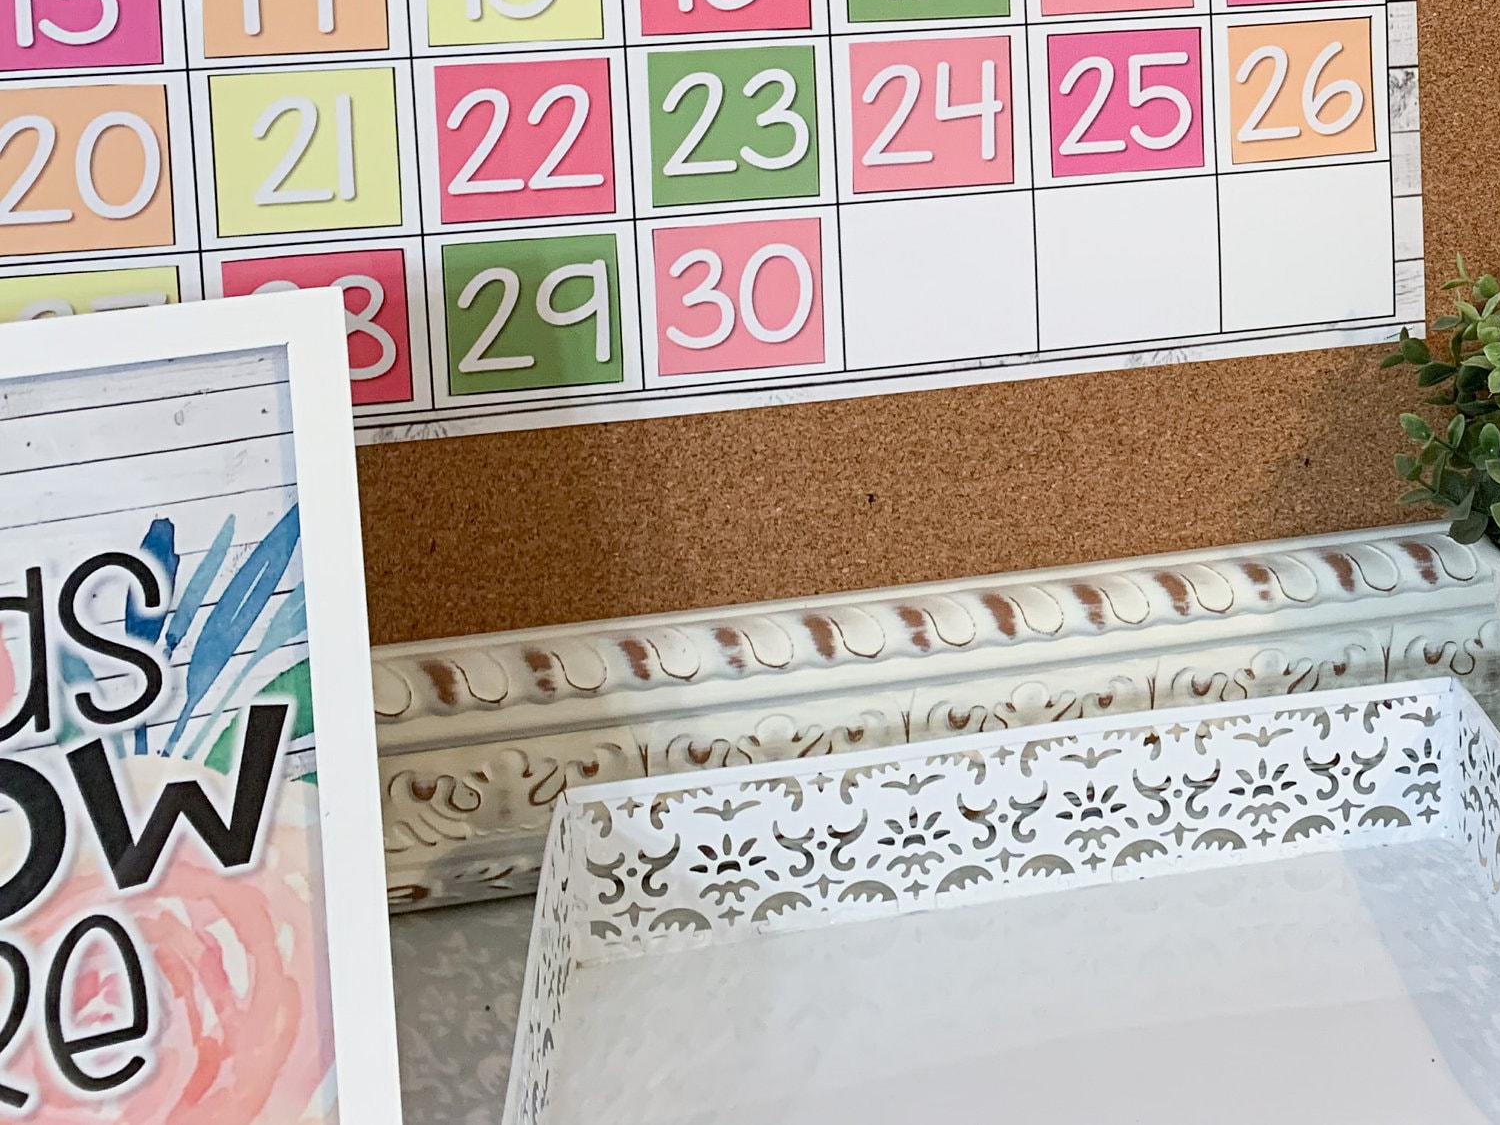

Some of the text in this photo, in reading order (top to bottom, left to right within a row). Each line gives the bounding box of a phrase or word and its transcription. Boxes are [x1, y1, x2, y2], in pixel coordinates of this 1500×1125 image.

[446, 83, 604, 196] 22
[662, 67, 810, 178] 23
[862, 59, 1003, 166] 24
[1057, 51, 1193, 156] 25
[1235, 41, 1365, 143] 26
[0, 110, 160, 225] 20
[252, 93, 357, 206] 21
[455, 258, 611, 374] 29
[665, 242, 814, 350] 30
